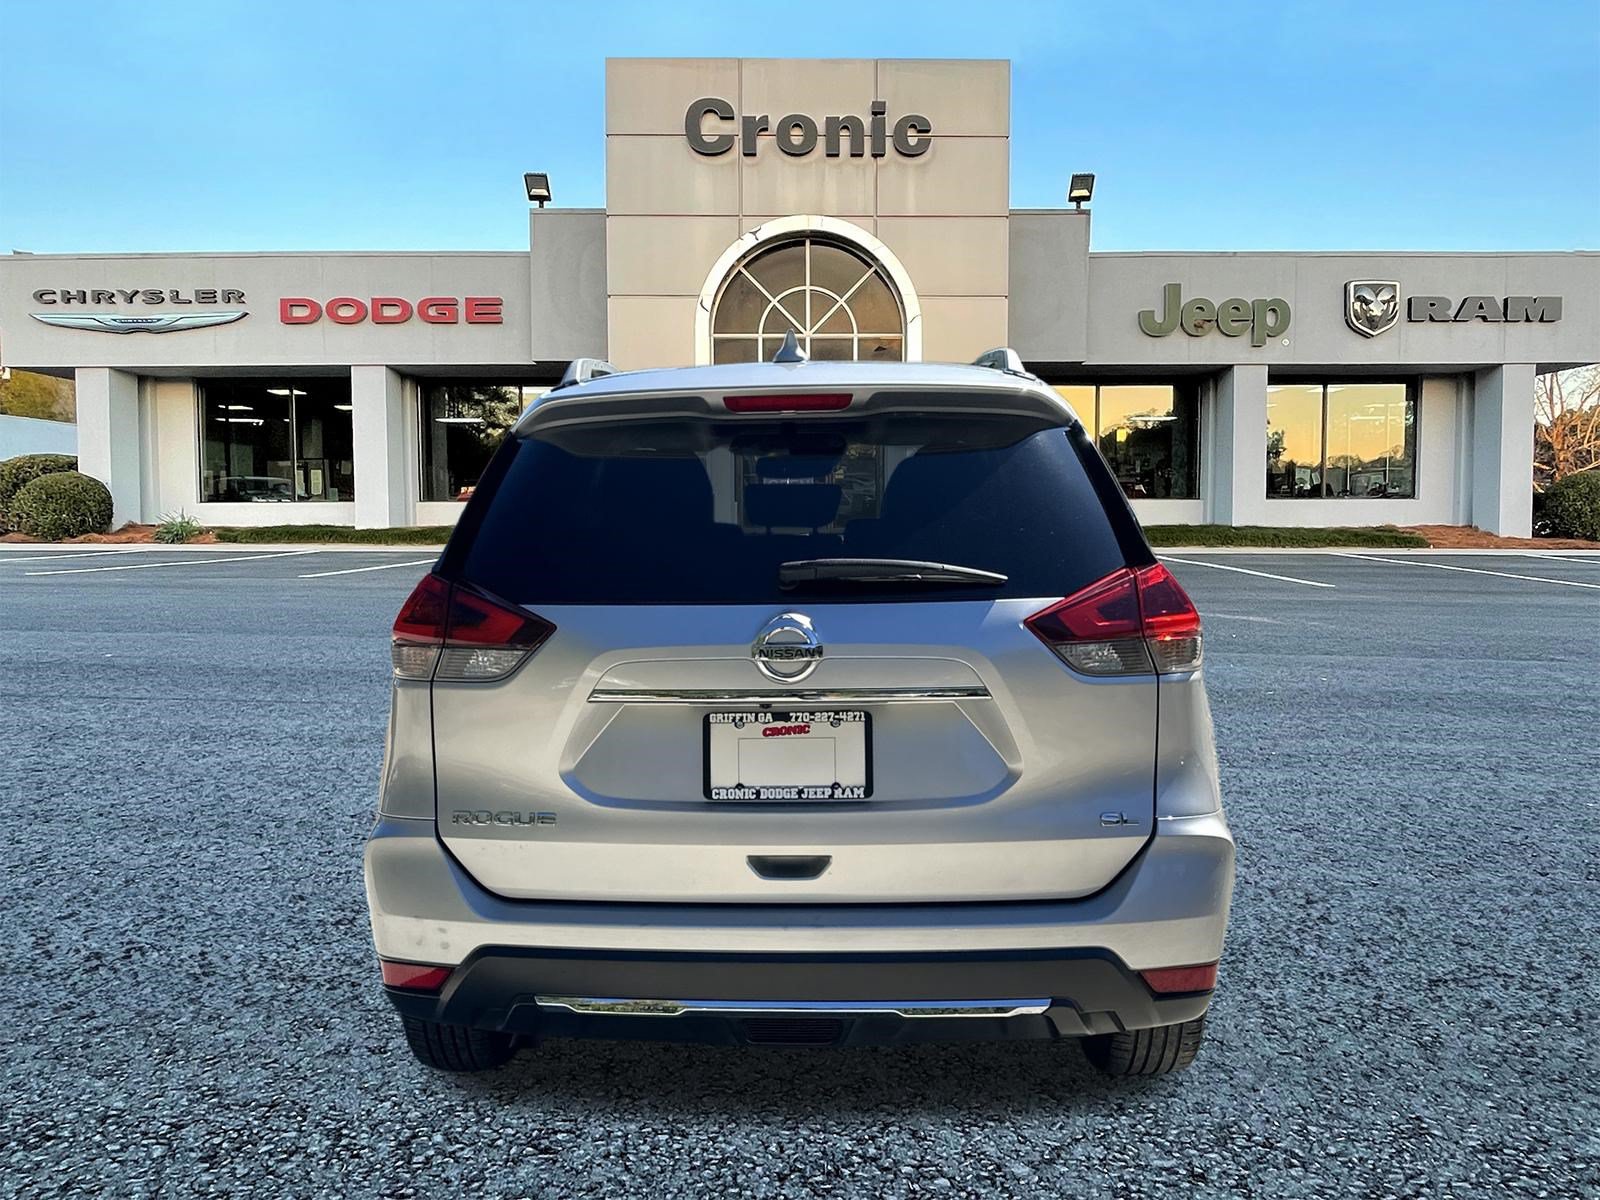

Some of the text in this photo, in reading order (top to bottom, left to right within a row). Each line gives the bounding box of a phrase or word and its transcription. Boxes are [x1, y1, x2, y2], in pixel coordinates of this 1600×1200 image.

[684, 97, 932, 157] Cronic
[32, 289, 246, 304] CHRYSLER
[279, 297, 503, 325] DODGE
[1138, 283, 1291, 347] Jeep
[1407, 296, 1563, 323] RAM
[758, 648, 815, 658] NISSAN
[709, 712, 773, 723] GRIFFIN GA
[789, 711, 866, 722] 770-227-4271
[762, 724, 811, 737] CRONIC
[711, 786, 865, 800] CRONIC DODGE JEEP RAM
[451, 810, 557, 826] ROGUE
[1099, 811, 1140, 827] SL
